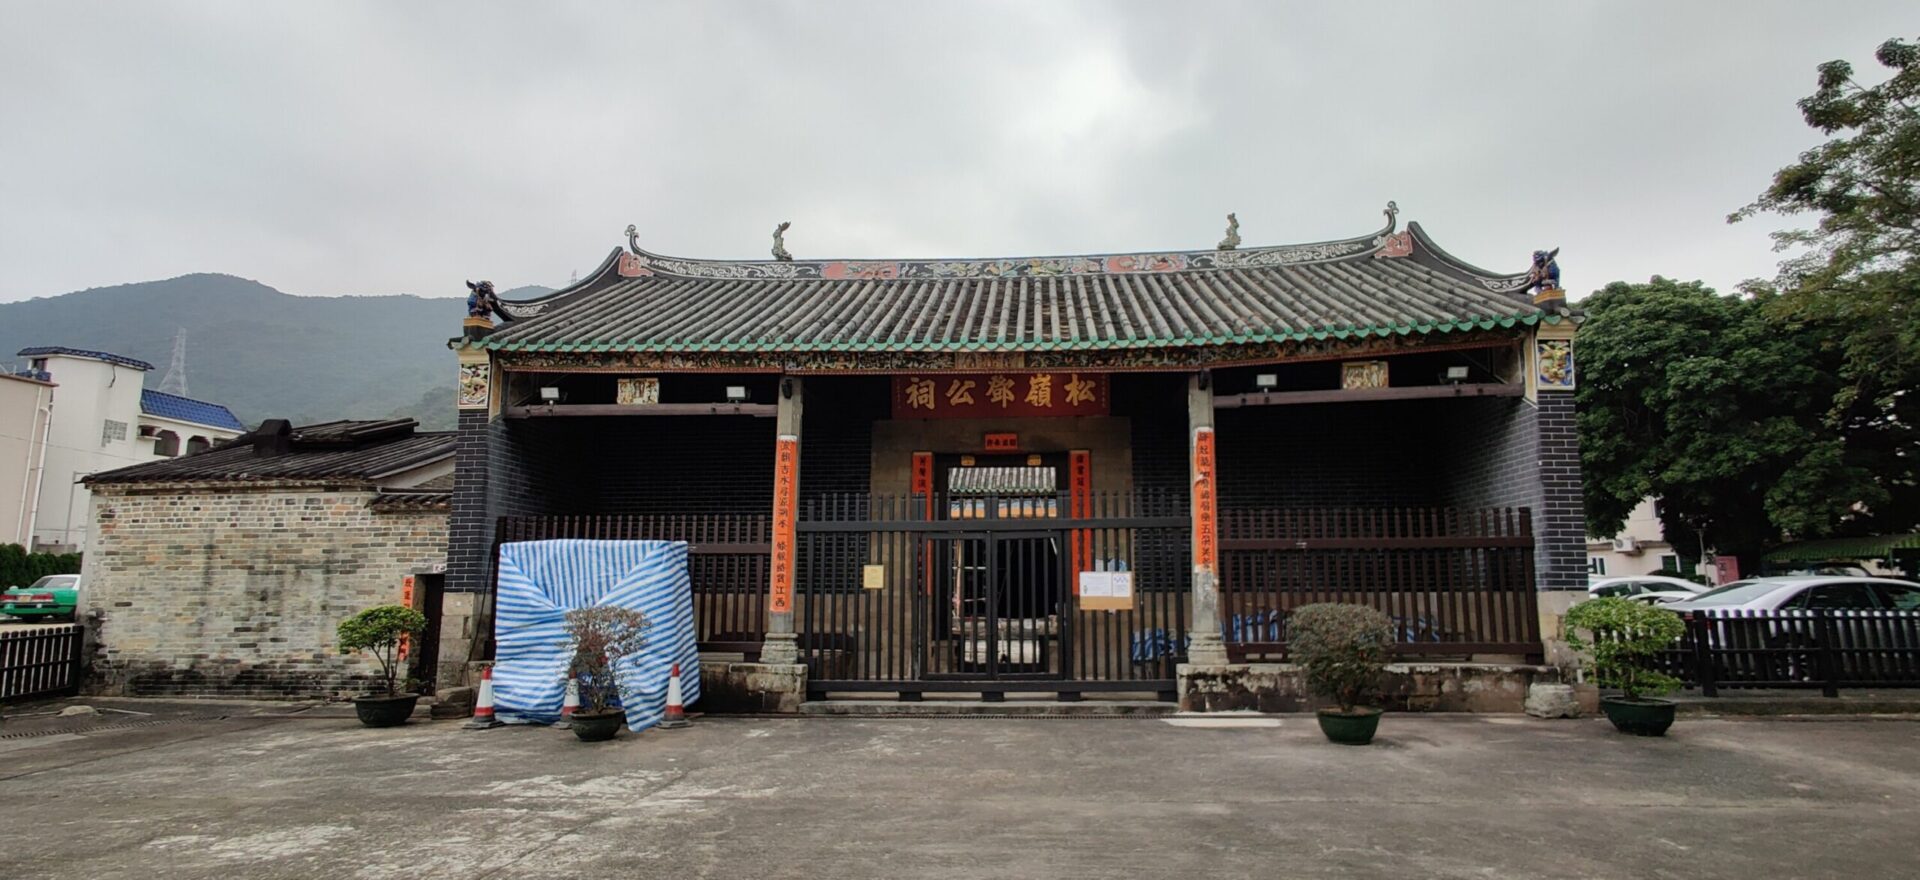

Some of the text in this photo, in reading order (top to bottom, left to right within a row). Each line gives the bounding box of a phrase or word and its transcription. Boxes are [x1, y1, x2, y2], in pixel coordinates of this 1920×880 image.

[905, 373, 1097, 410] 松嶺鄧公祠
